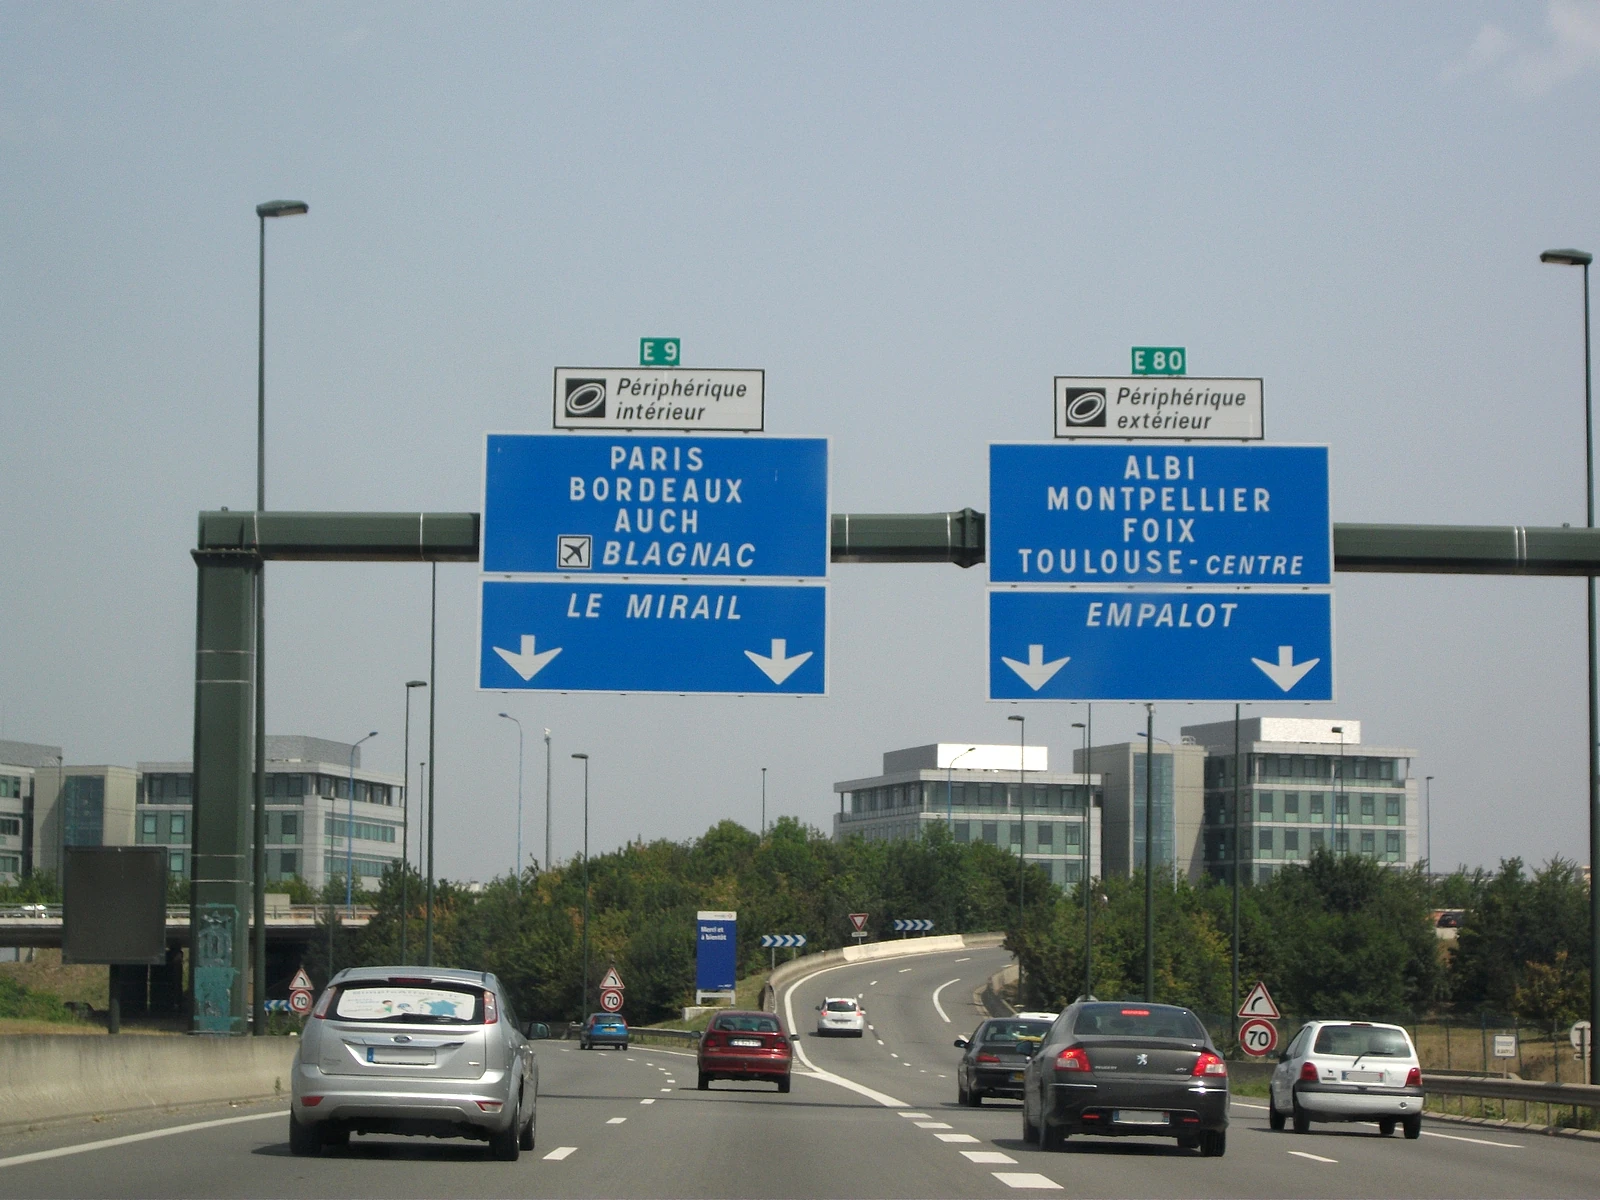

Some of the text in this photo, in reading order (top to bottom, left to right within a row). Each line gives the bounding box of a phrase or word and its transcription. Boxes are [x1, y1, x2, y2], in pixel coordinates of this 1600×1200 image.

[643, 341, 678, 362] E 9
[1134, 351, 1183, 371] E 80
[617, 377, 747, 399] Périphérique
[1116, 387, 1246, 410] Périphérique
[616, 402, 706, 421] intérieur
[1117, 412, 1212, 430] extérieur
[610, 446, 703, 471] PARIS
[1124, 456, 1194, 480] ALBI
[569, 477, 742, 503] BORDEAUX
[1047, 486, 1270, 512] MONTPELLIER
[614, 509, 698, 534] AUCH
[1123, 518, 1195, 543] FOIX
[602, 541, 756, 567] BLAGNAC
[567, 593, 742, 620] LE MIRAIL
[1086, 602, 1238, 627] EMPALOT
[296, 997, 307, 1006] 70
[606, 996, 619, 1006] 70
[1248, 1030, 1269, 1047] 70
